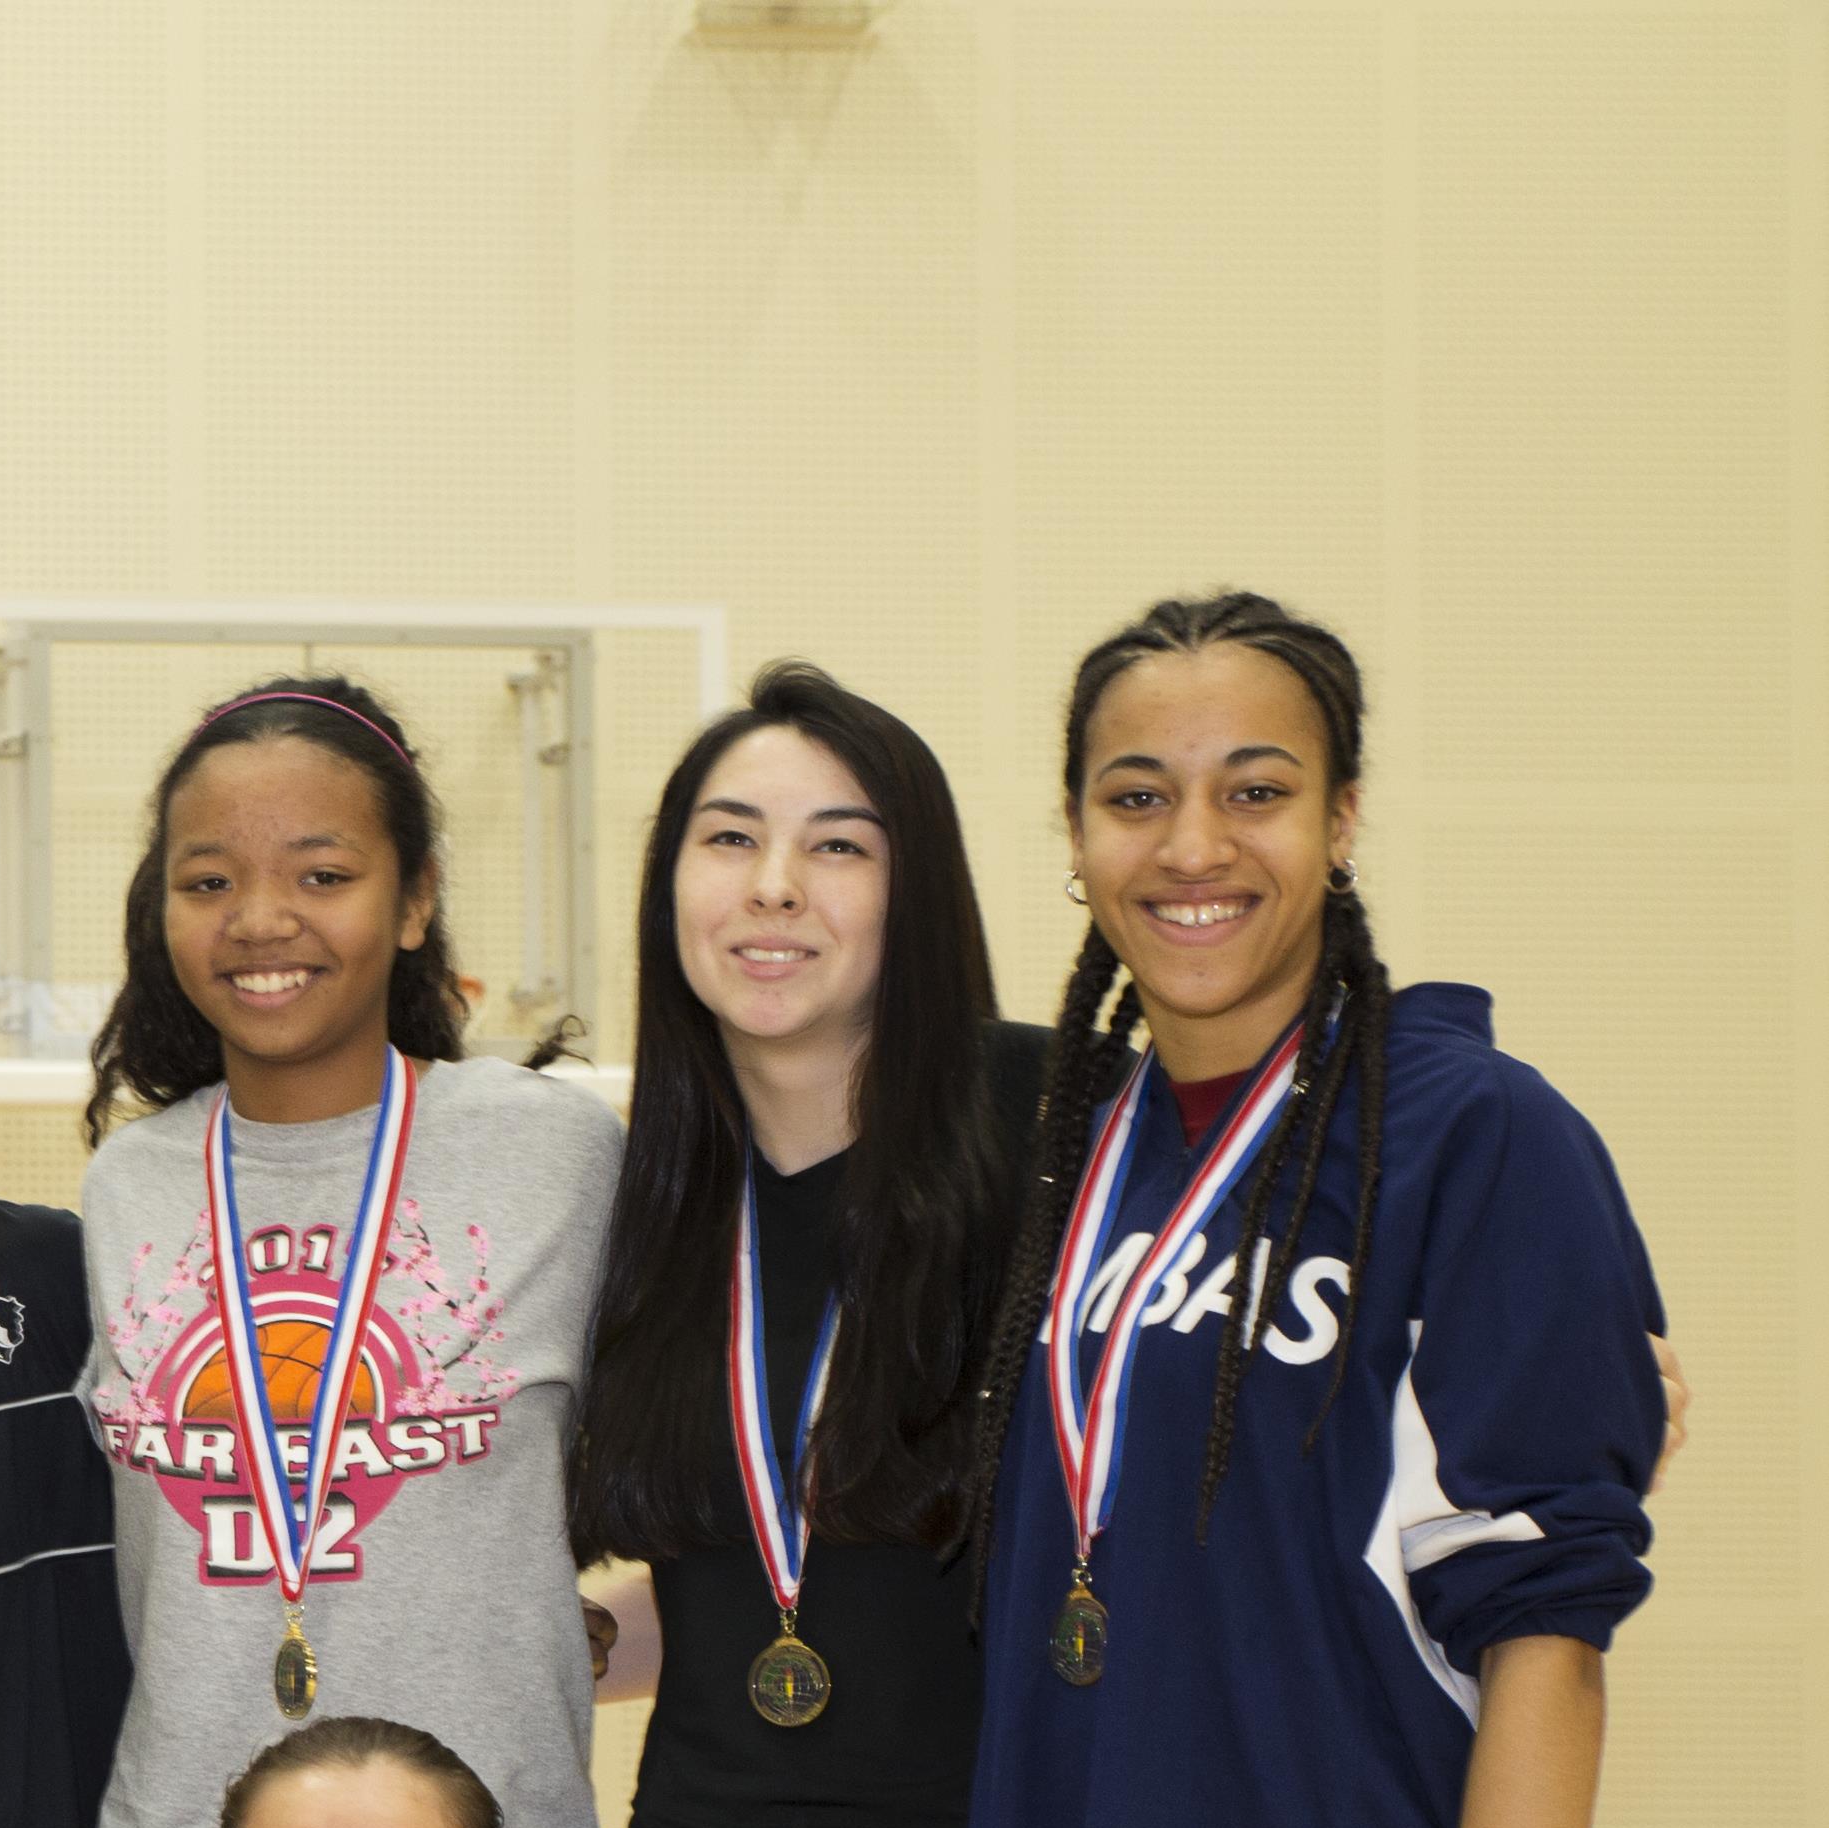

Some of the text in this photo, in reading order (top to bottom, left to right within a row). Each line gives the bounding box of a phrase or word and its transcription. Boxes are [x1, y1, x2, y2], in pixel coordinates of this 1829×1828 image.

[105, 1410, 497, 1484] FAR EAST
[201, 1491, 357, 1578] D2
